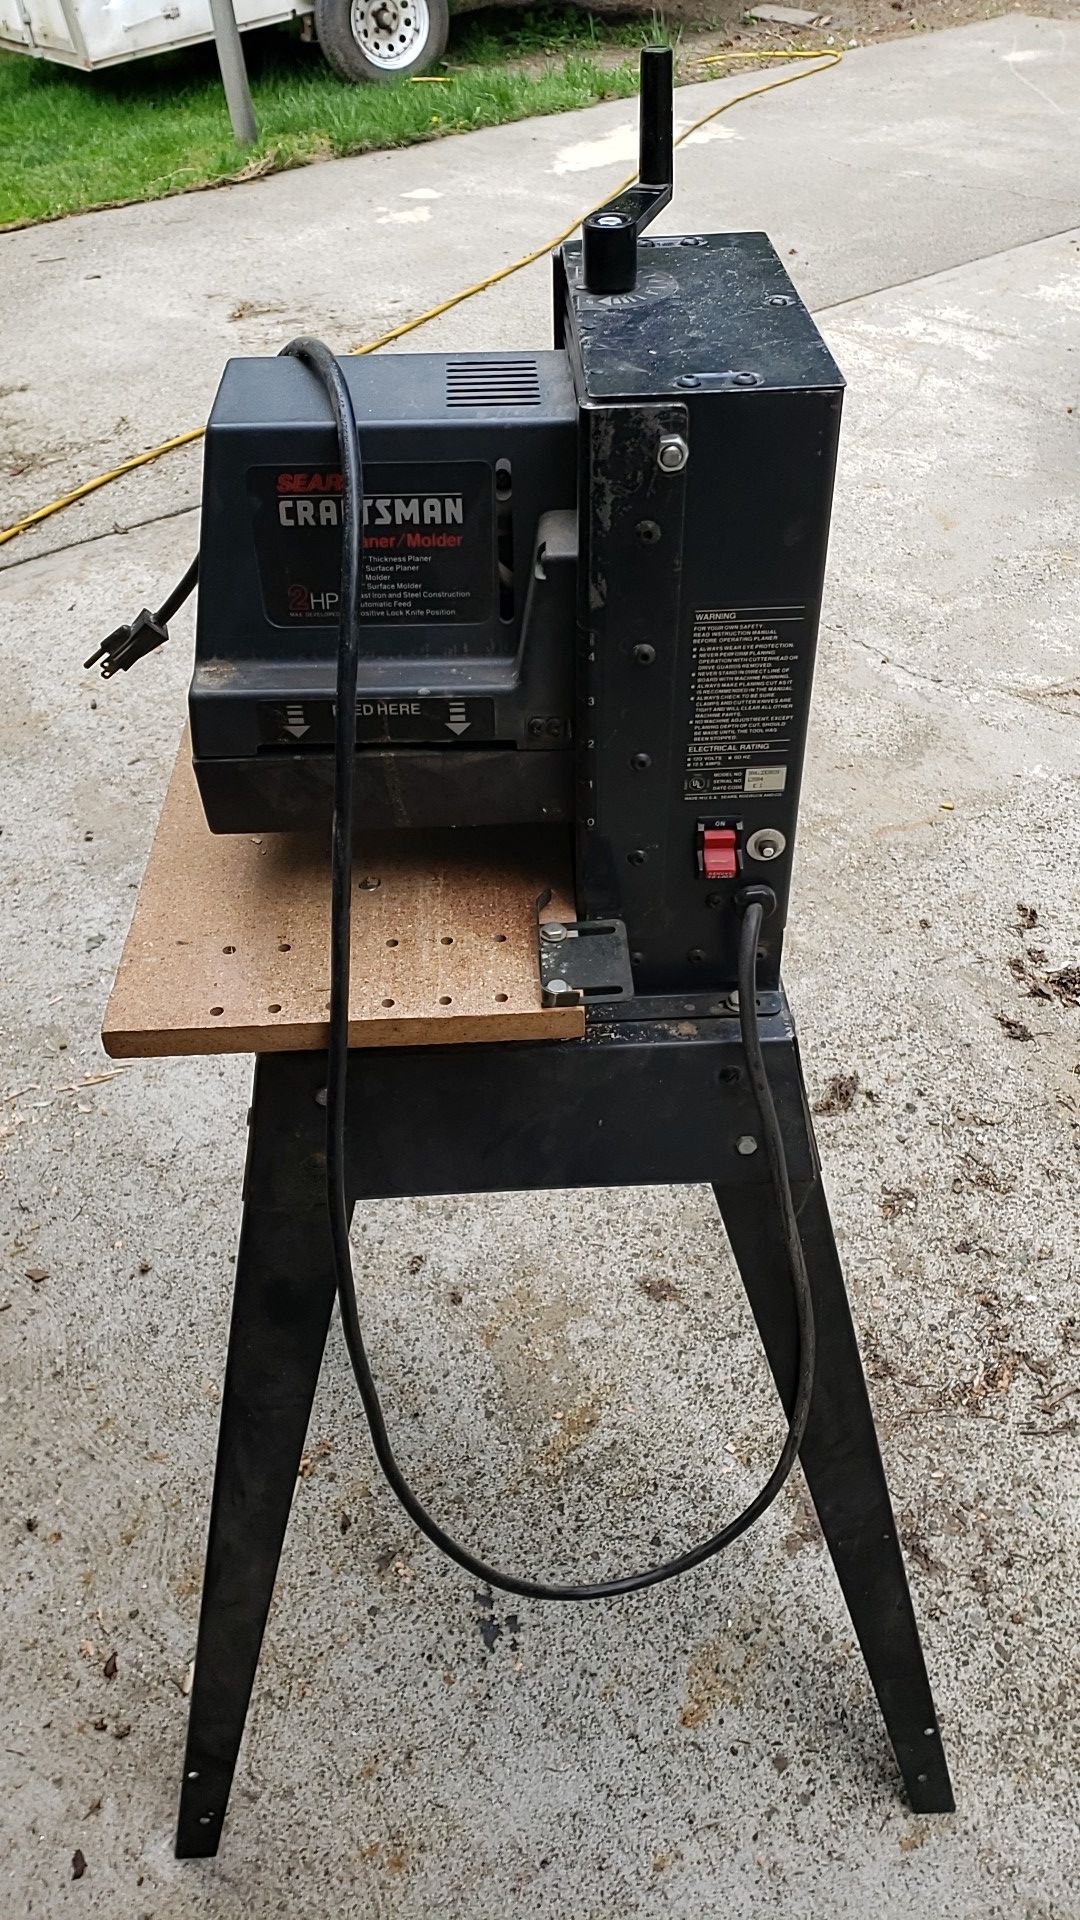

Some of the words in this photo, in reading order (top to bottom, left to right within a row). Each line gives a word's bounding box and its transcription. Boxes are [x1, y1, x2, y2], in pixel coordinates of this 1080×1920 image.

[278, 474, 344, 492] SEAR
[279, 498, 464, 526] CRATSMAN
[362, 533, 464, 549] aner/Molder
[695, 612, 737, 621] WARNING
[588, 652, 595, 662] 4
[588, 696, 595, 706] 3
[376, 703, 422, 716] HERE
[588, 739, 595, 749] 2
[588, 817, 595, 827] 0
